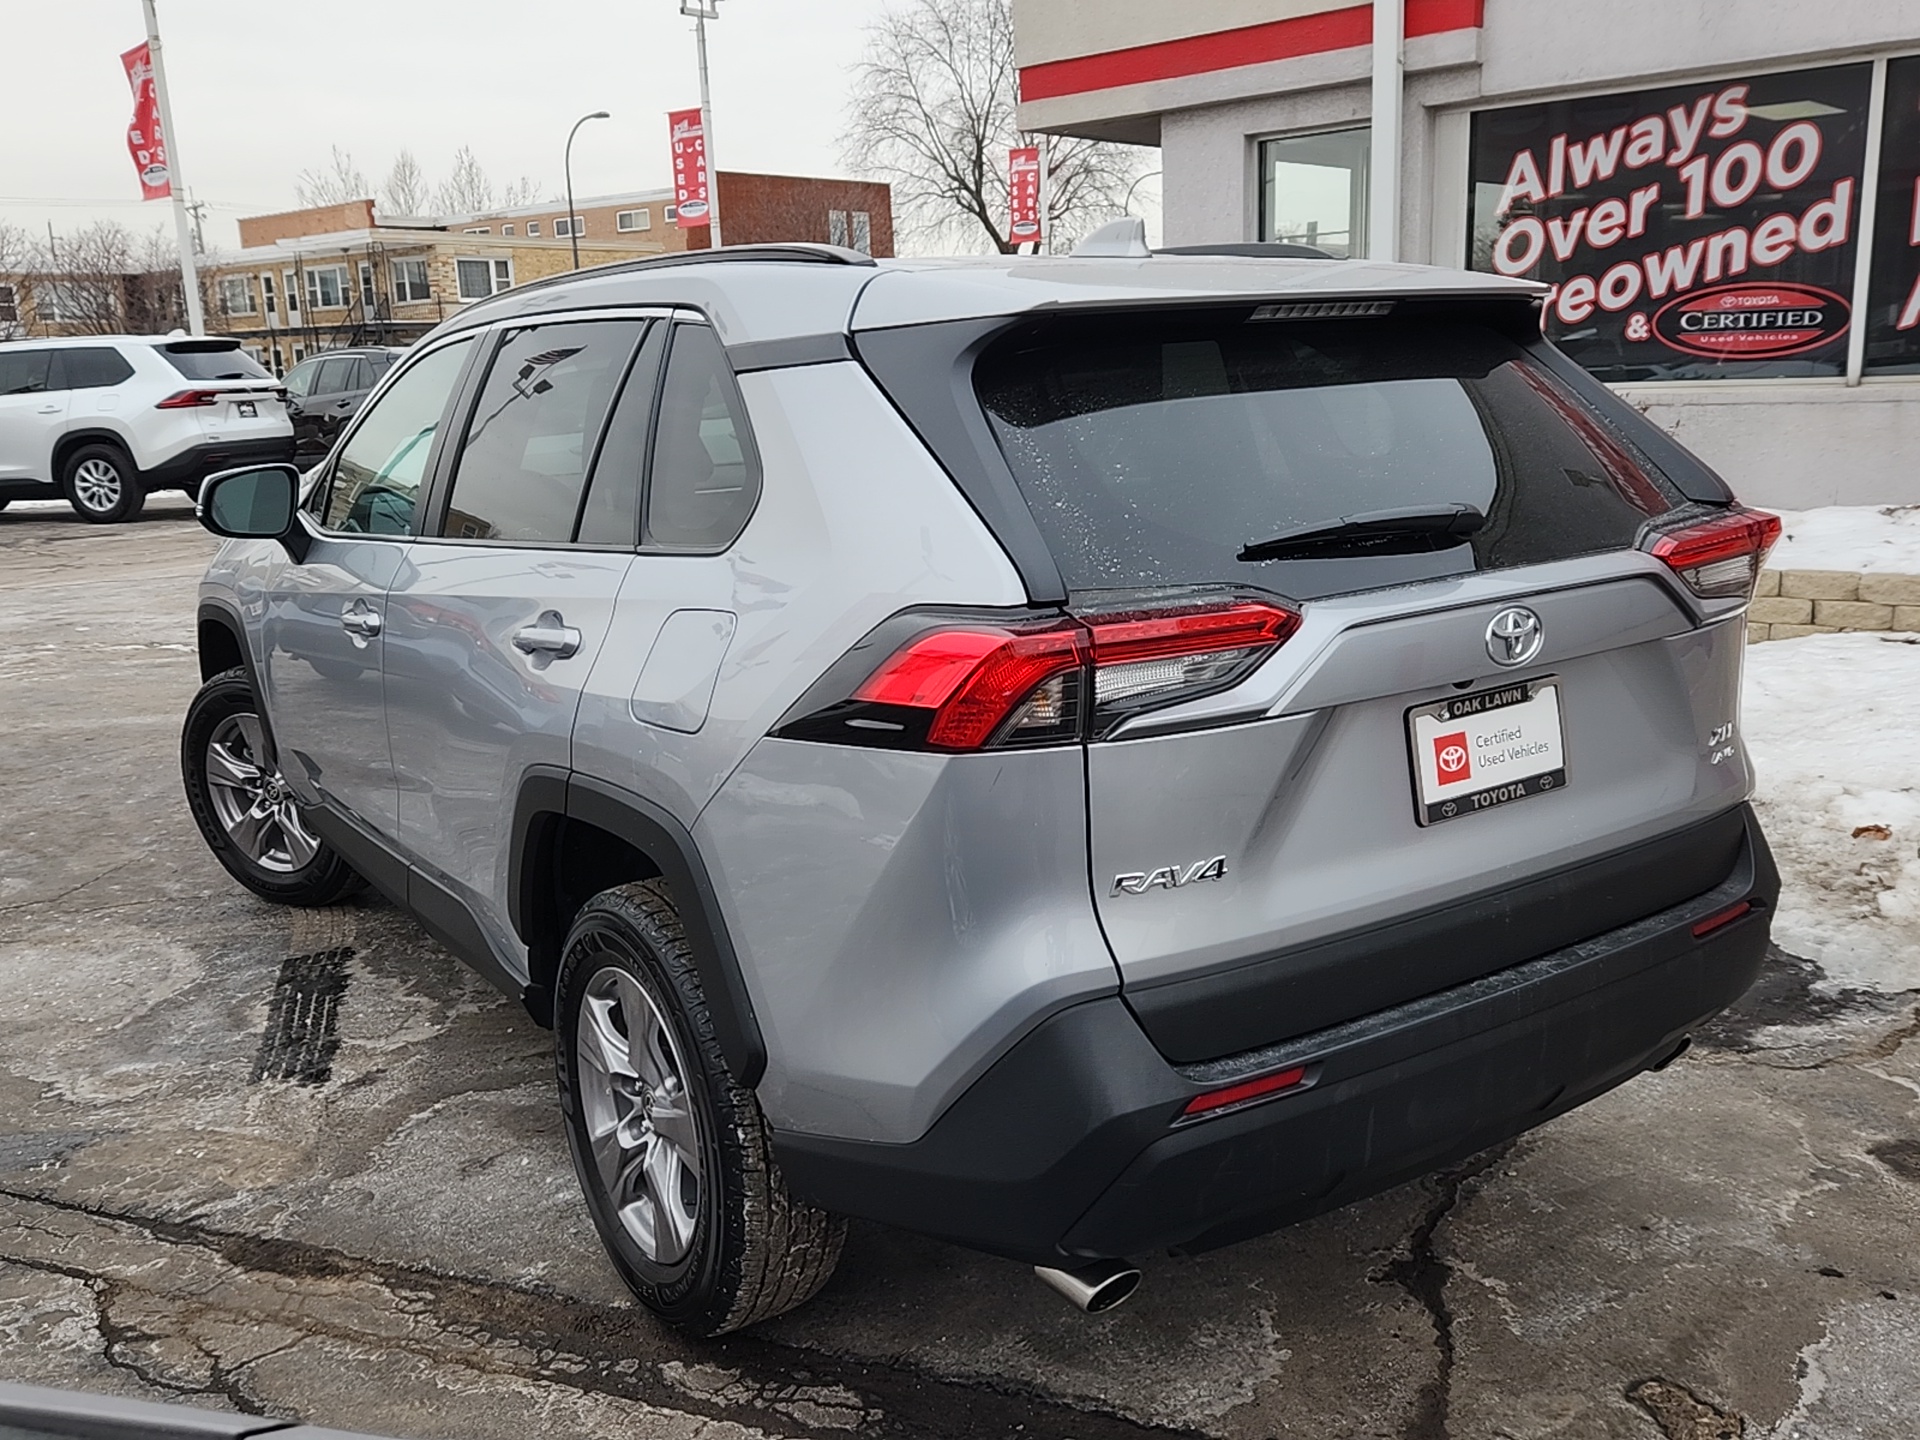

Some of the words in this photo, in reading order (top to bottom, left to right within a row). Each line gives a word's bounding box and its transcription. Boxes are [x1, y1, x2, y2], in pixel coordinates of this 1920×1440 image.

[1496, 85, 1750, 215] Always
[674, 142, 688, 201] USED
[694, 139, 706, 199] CARS
[1012, 173, 1021, 221] USED
[1026, 172, 1036, 220] CARS
[1493, 183, 1659, 276] Over
[1679, 121, 1823, 220] 100
[1541, 177, 1854, 330] reowned
[1737, 295, 1779, 306] TOYOTA
[1625, 312, 1650, 342] &
[1680, 310, 1823, 331] CERTIFIED
[1700, 334, 1734, 343] Used
[1739, 333, 1798, 342] Vehicles
[1453, 699, 1482, 716] OAK
[1485, 688, 1522, 708] LAWN
[1475, 726, 1522, 748] Certified
[1478, 752, 1505, 768] Used
[1507, 741, 1549, 761] Vehicles
[1471, 783, 1526, 809] TOYOTA
[1109, 855, 1229, 898] RAV4
